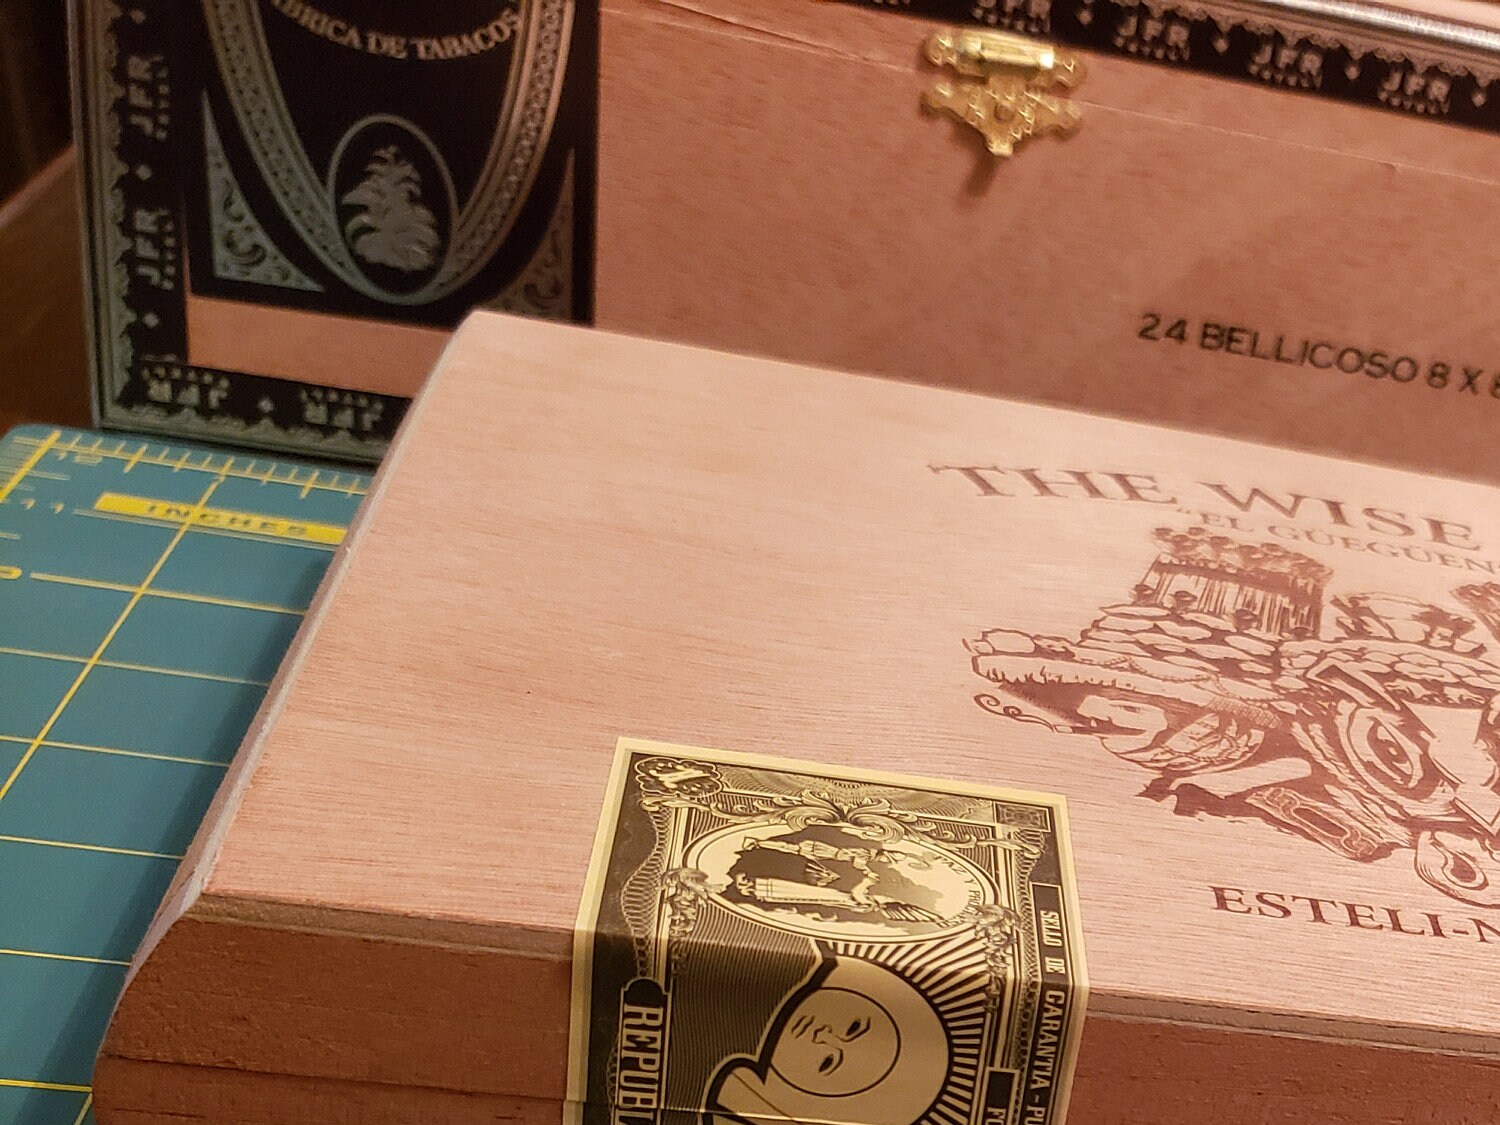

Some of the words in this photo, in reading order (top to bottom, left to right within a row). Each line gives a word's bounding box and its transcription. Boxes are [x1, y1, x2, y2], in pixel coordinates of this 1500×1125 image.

[367, 32, 407, 59] DE
[1138, 312, 1187, 346] 24
[1199, 321, 1418, 385] BELLICOSO
[1426, 361, 1449, 388] 8
[927, 463, 1177, 505] THE
[1197, 480, 1482, 552] WISE
[1040, 910, 1063, 948] SELLO
[1045, 958, 1066, 975] DE
